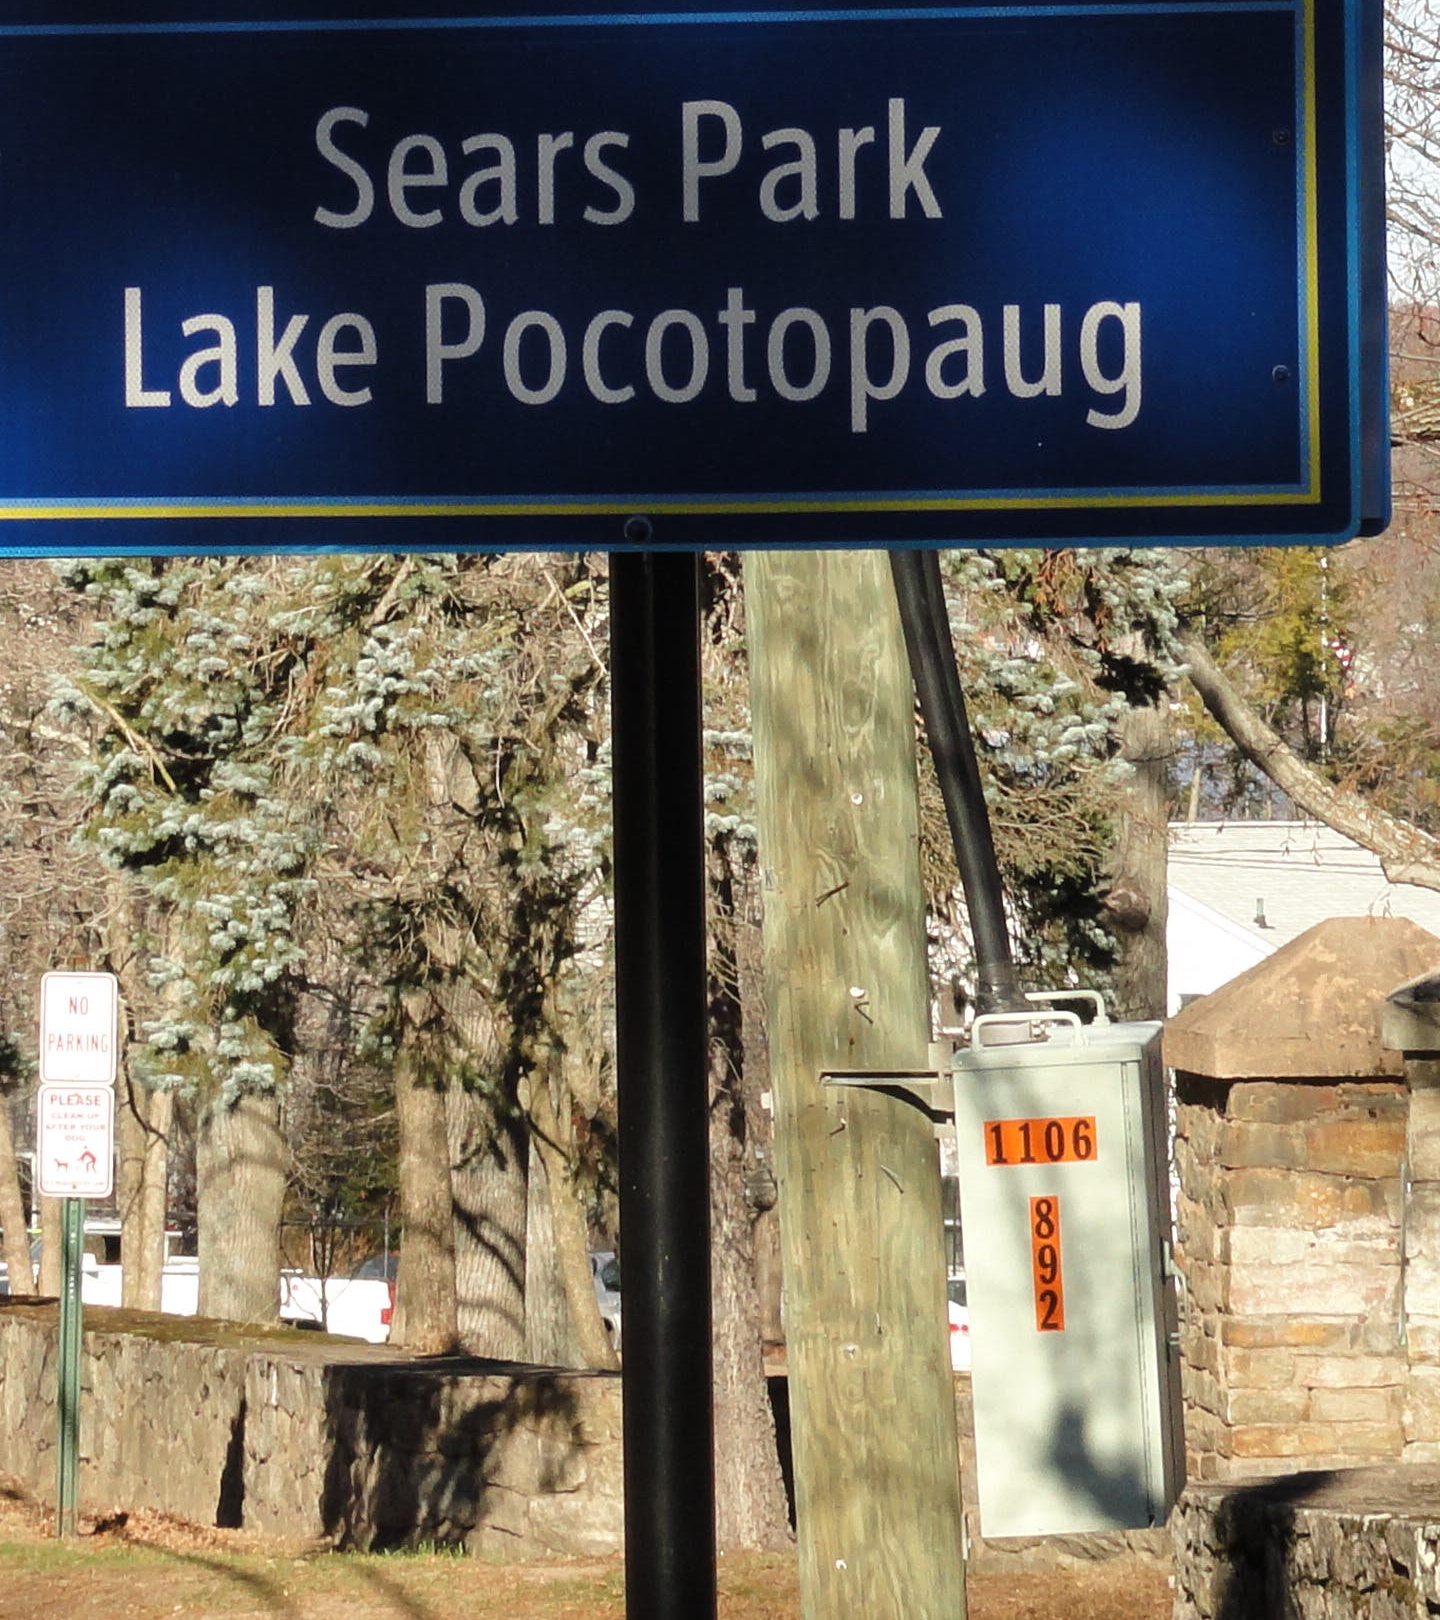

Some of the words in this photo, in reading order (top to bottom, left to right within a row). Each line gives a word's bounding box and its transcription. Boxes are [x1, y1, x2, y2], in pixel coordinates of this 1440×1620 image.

[312, 105, 636, 231] Sears
[680, 96, 943, 224] Park
[123, 285, 378, 410] Lake
[425, 281, 1145, 435] Pocotopaug
[69, 996, 88, 1015] NO
[48, 1033, 108, 1053] PARKING
[50, 1094, 101, 1106] PLEASE
[990, 1119, 1093, 1164] 1106
[1034, 1198, 1059, 1330] 892
